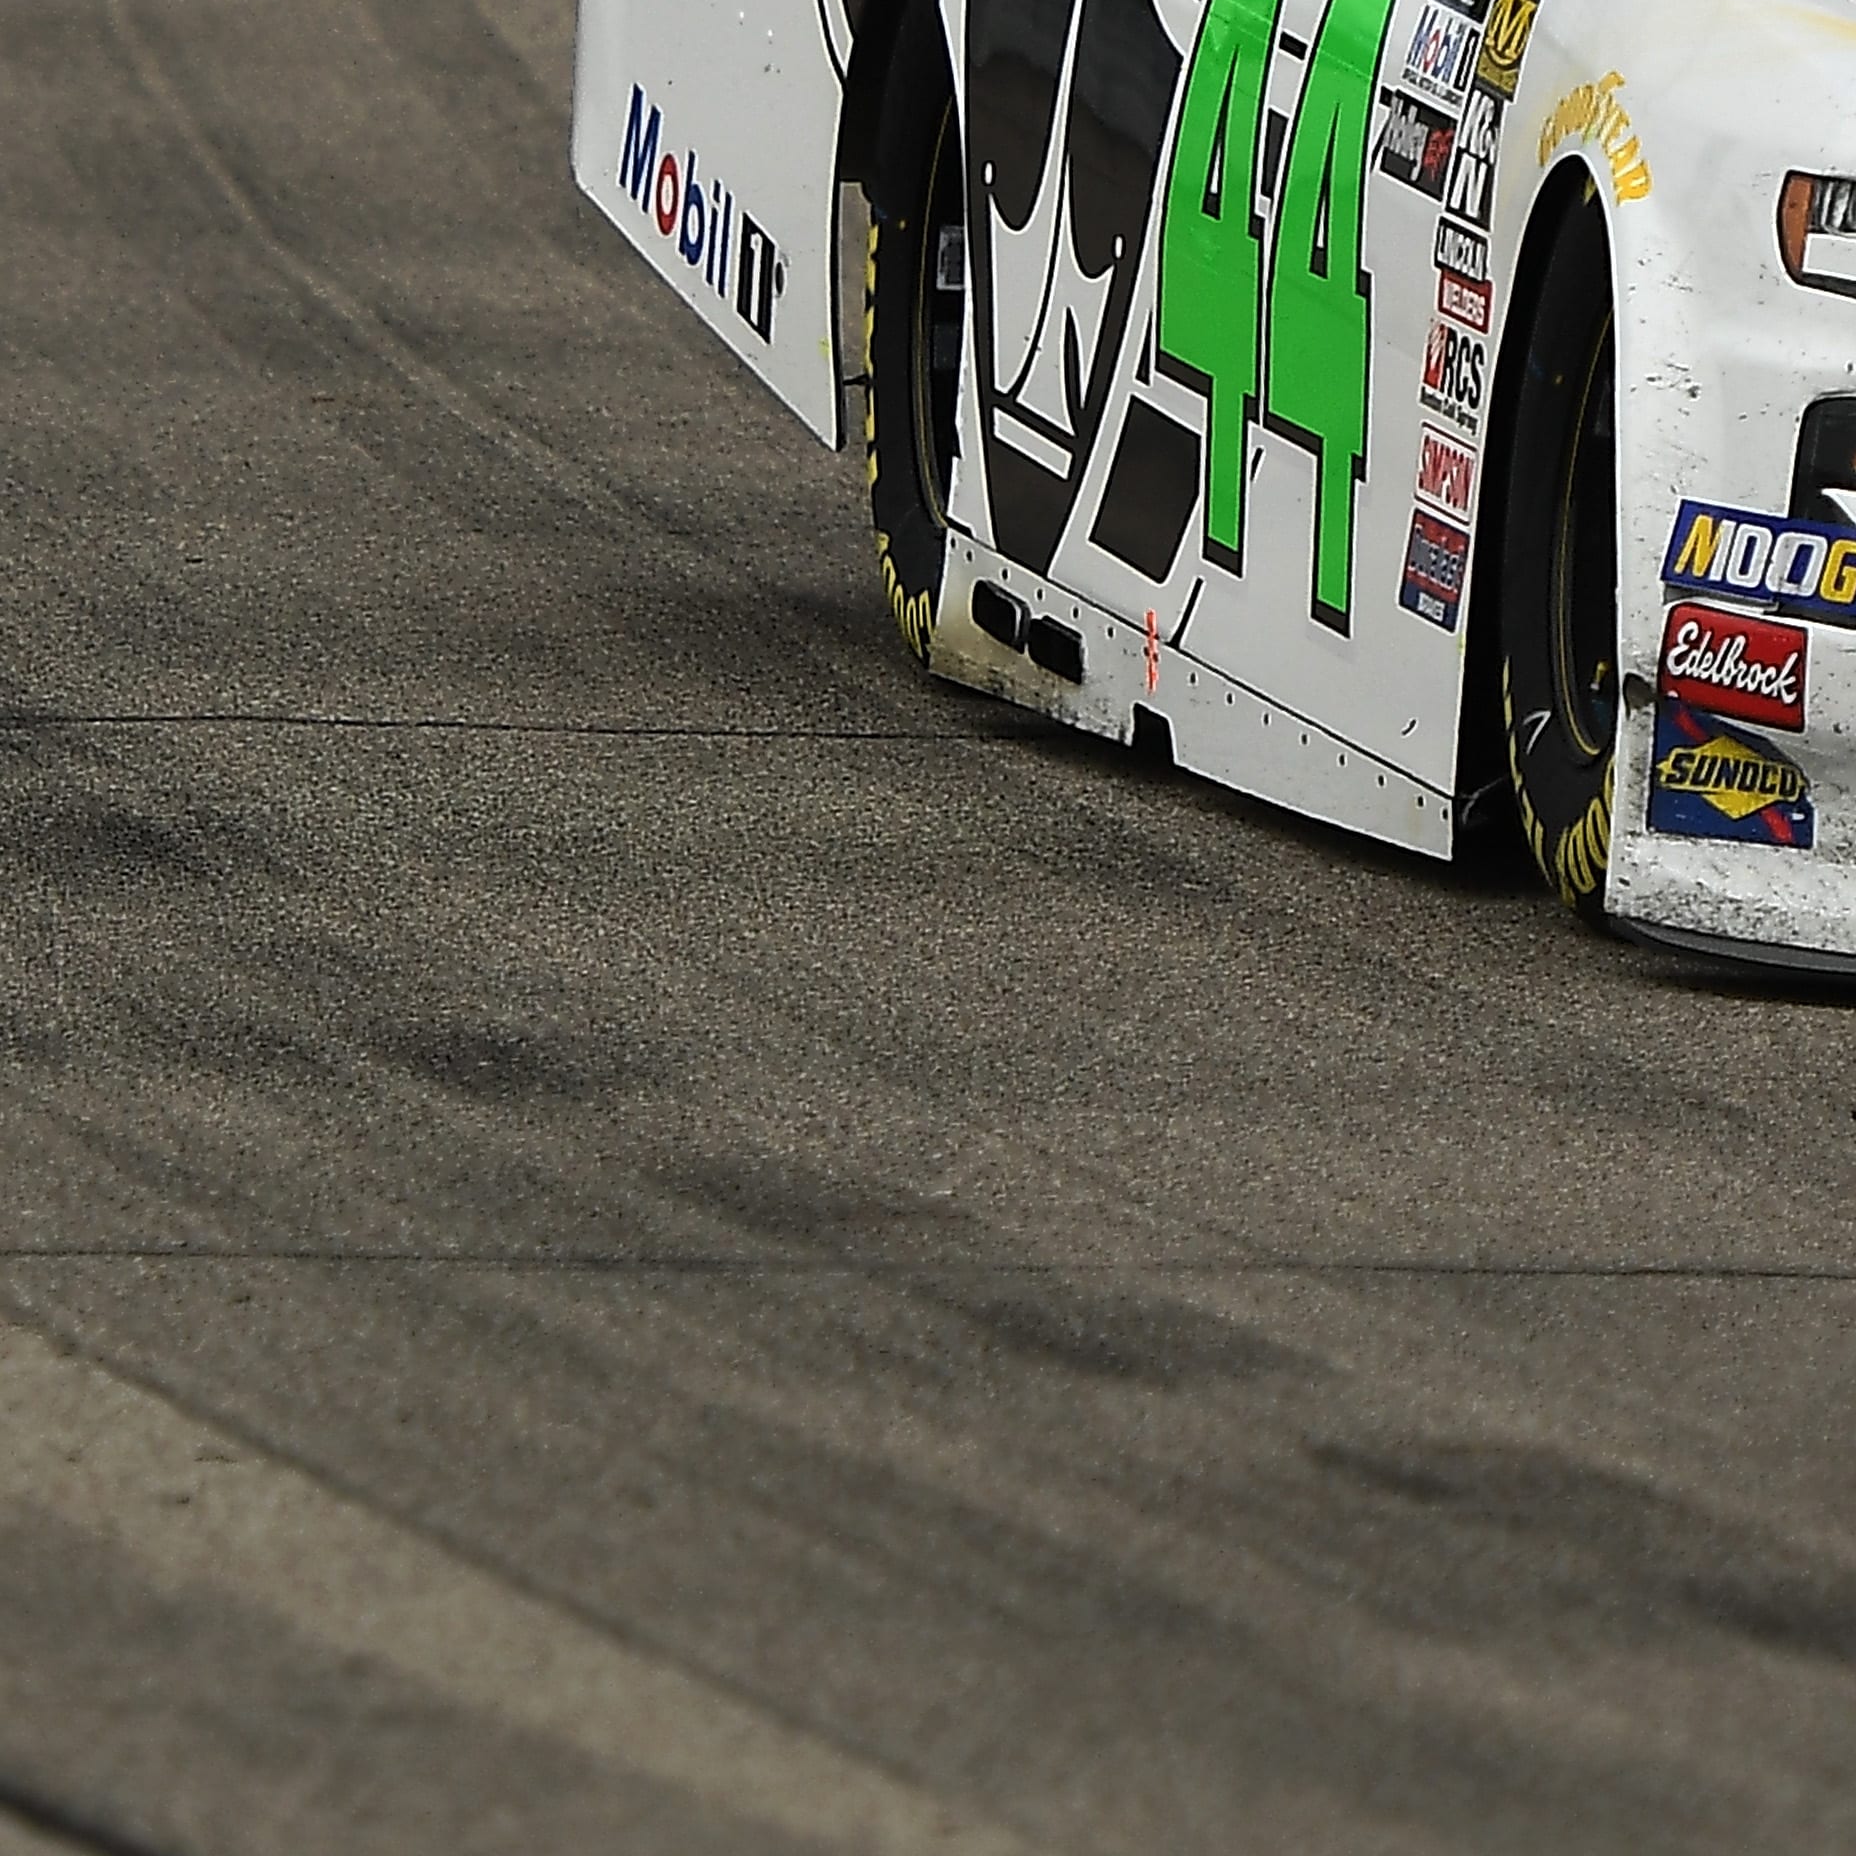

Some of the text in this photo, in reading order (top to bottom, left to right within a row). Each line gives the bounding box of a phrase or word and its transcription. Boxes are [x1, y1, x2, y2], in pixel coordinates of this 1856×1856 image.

[617, 81, 734, 299] Mobil
[1439, 325, 1486, 410] RCS
[1666, 620, 1798, 705] Edelbrock
[1664, 752, 1804, 799] SUNOCO
